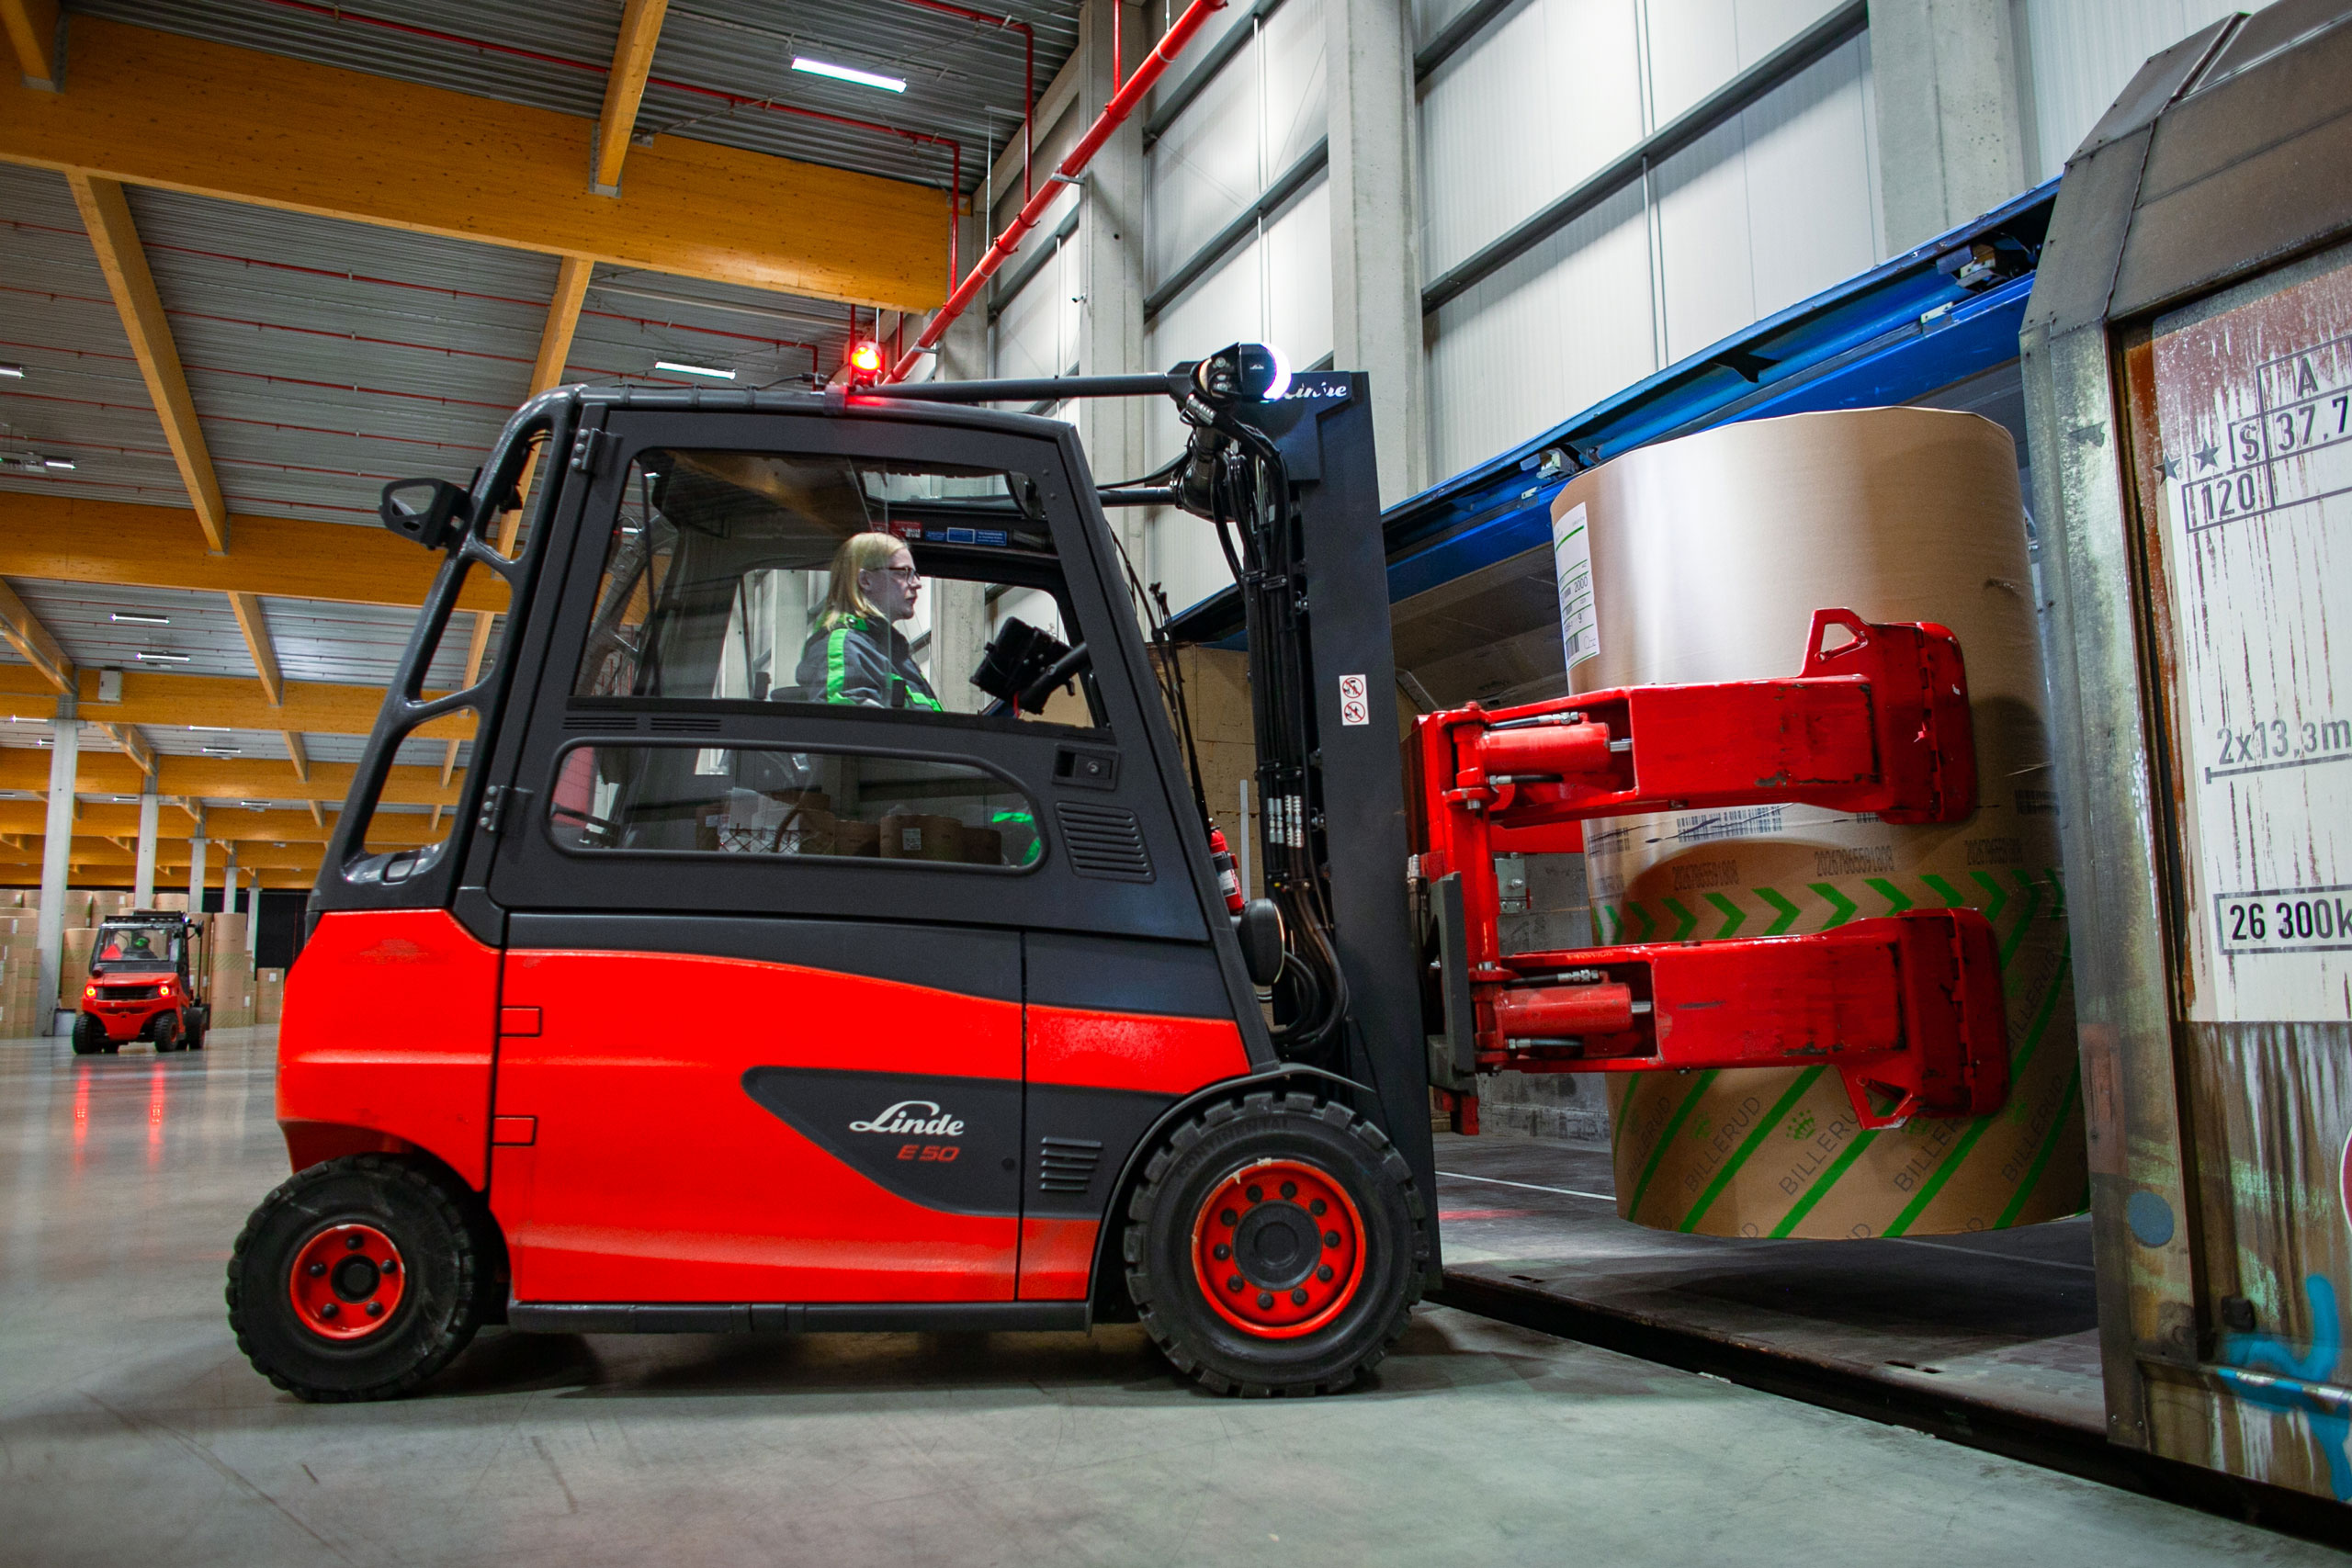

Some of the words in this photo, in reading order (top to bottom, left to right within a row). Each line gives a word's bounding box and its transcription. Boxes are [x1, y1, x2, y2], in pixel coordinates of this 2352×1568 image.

[2296, 356, 2319, 398] A
[2238, 423, 2260, 462] S
[2200, 473, 2256, 521] 120
[2216, 718, 2352, 765] 2x13,3m
[2229, 903, 2266, 941] 26
[848, 1100, 965, 1136] Linde
[1627, 1095, 1671, 1184] BILLERUD
[2001, 1074, 2064, 1183] BILLERUD
[897, 1144, 919, 1160] E
[920, 1145, 961, 1162] 50
[1684, 1096, 1761, 1193] BILLERUD
[1778, 1093, 1872, 1196] BILLERU
[1893, 1118, 1962, 1193] BILLER
